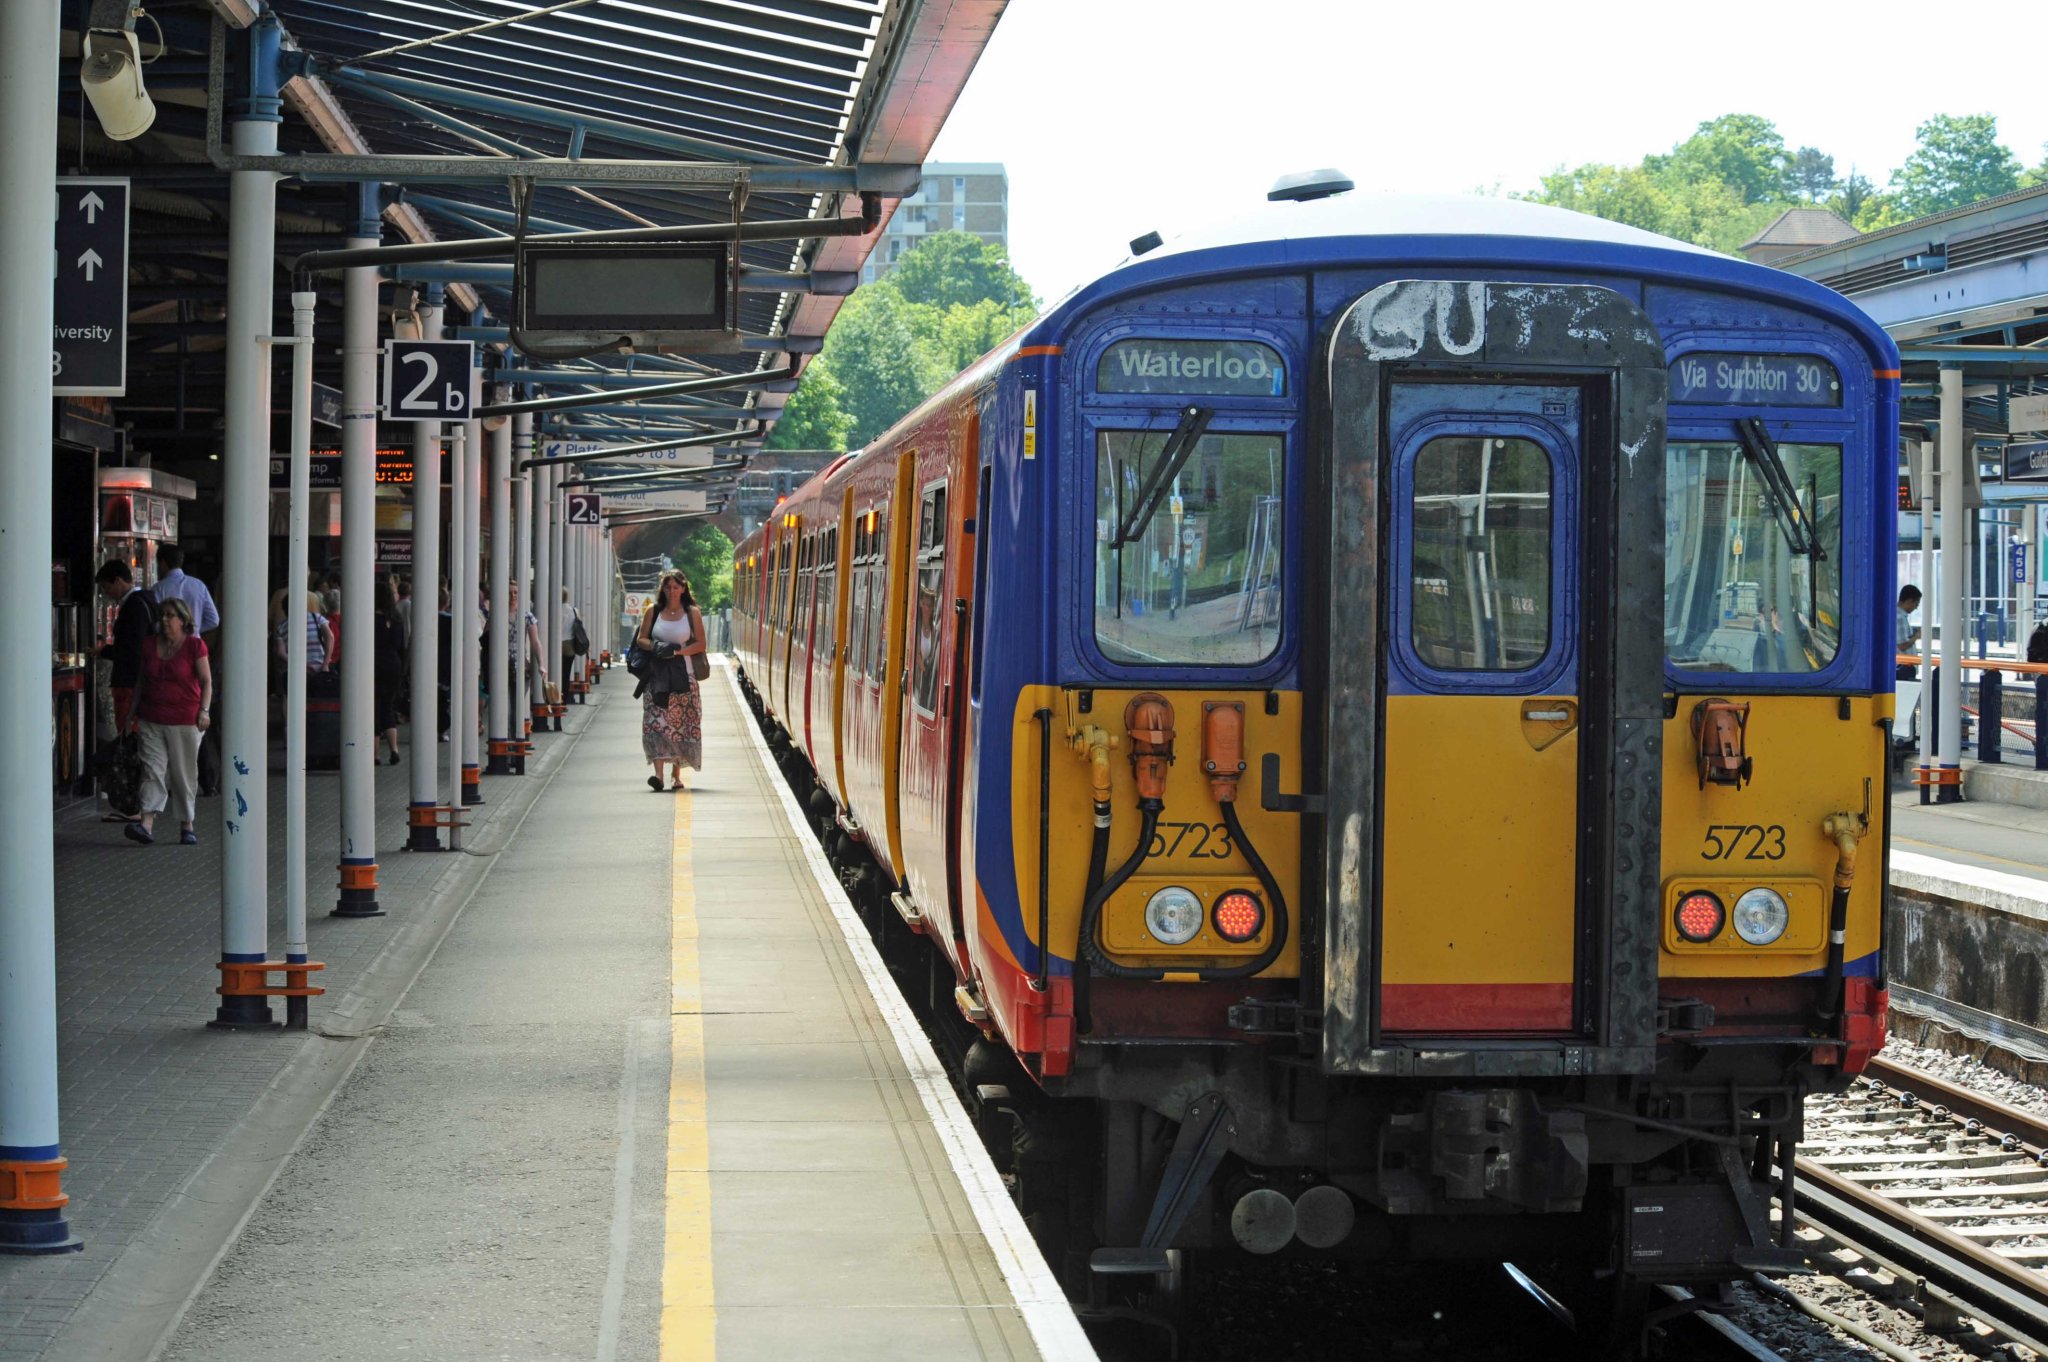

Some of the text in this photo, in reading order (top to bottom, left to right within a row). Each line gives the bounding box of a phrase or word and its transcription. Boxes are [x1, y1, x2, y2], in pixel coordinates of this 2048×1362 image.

[54, 325, 112, 342] iversity
[1118, 349, 1267, 380] Waterloo
[1680, 359, 1821, 393] Via Surbiton 30
[309, 463, 328, 476] mp
[380, 542, 412, 552] Passenger
[380, 552, 412, 561] assistance
[1146, 822, 1232, 859] 5723
[1701, 824, 1786, 860] 5723
